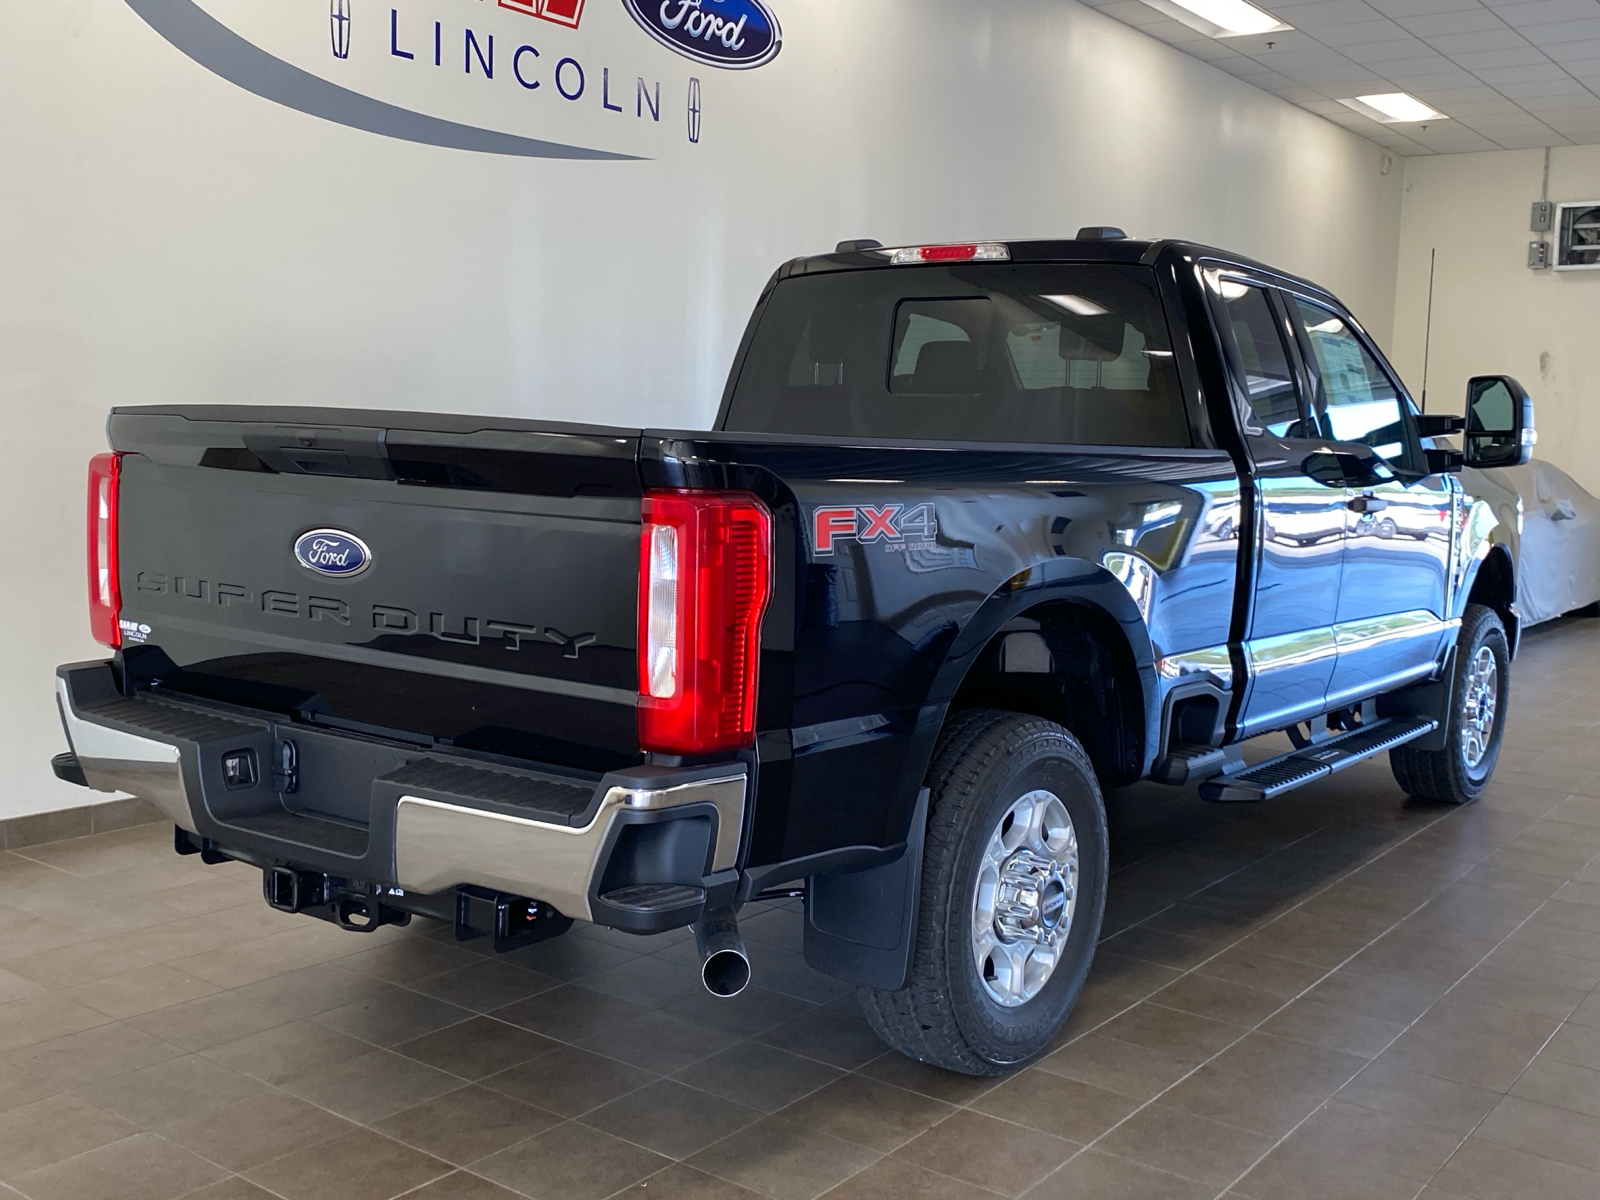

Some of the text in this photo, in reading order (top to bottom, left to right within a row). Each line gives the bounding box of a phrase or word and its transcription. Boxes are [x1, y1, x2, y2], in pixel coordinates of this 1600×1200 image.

[660, 0, 748, 50] Ford
[390, 8, 660, 122] LINCOLN
[309, 538, 350, 567] Ford
[813, 503, 938, 557] FX4
[123, 629, 147, 639] LINCOLN
[137, 571, 597, 659] SUPER DUTY
